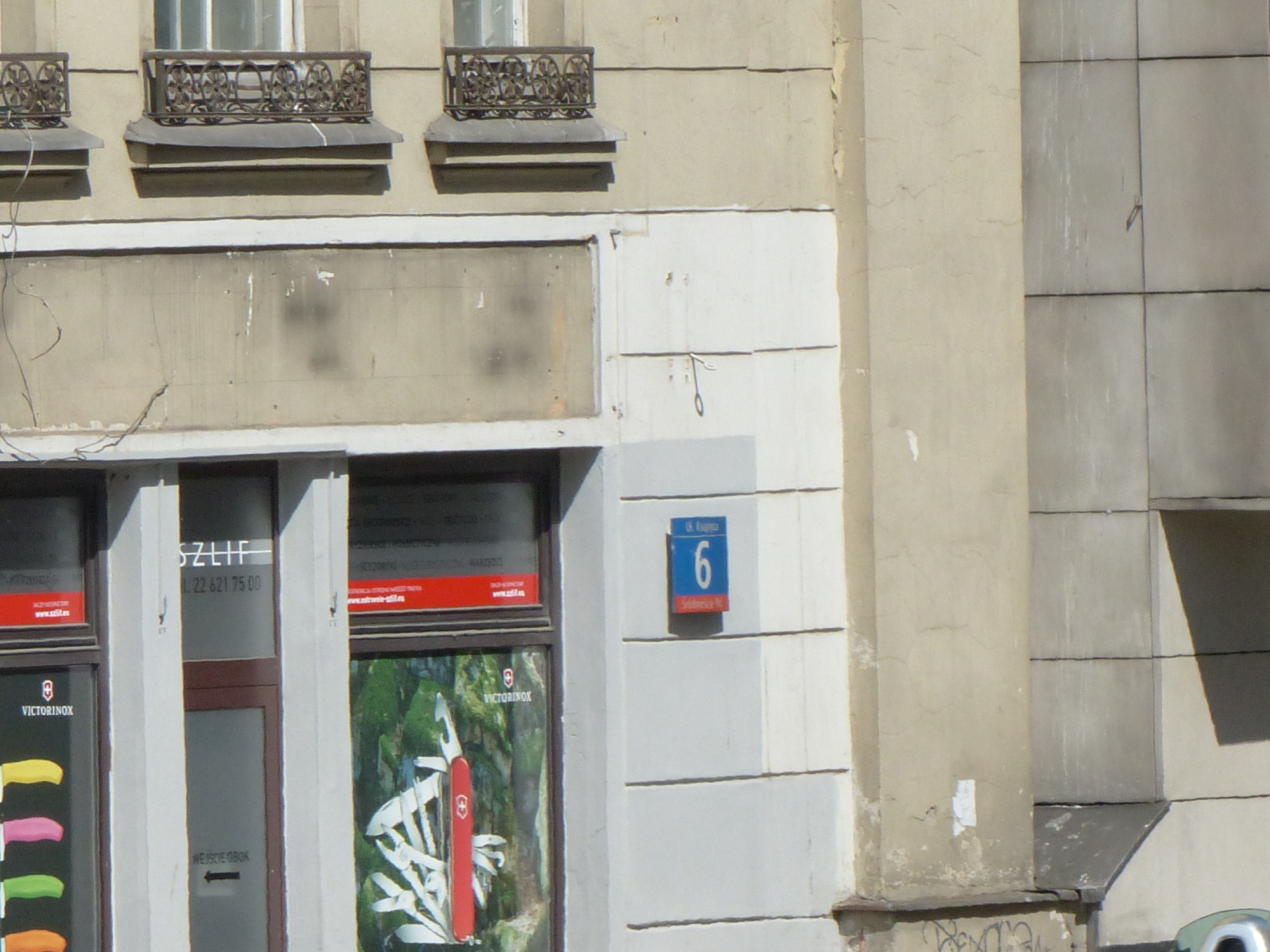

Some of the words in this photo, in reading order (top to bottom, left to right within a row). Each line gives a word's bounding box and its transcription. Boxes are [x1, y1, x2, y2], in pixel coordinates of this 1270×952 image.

[180, 540, 249, 567] SZLIF
[695, 540, 711, 589] 6
[484, 691, 532, 704] VICTORINOX
[22, 705, 74, 716] VICTORINOX
